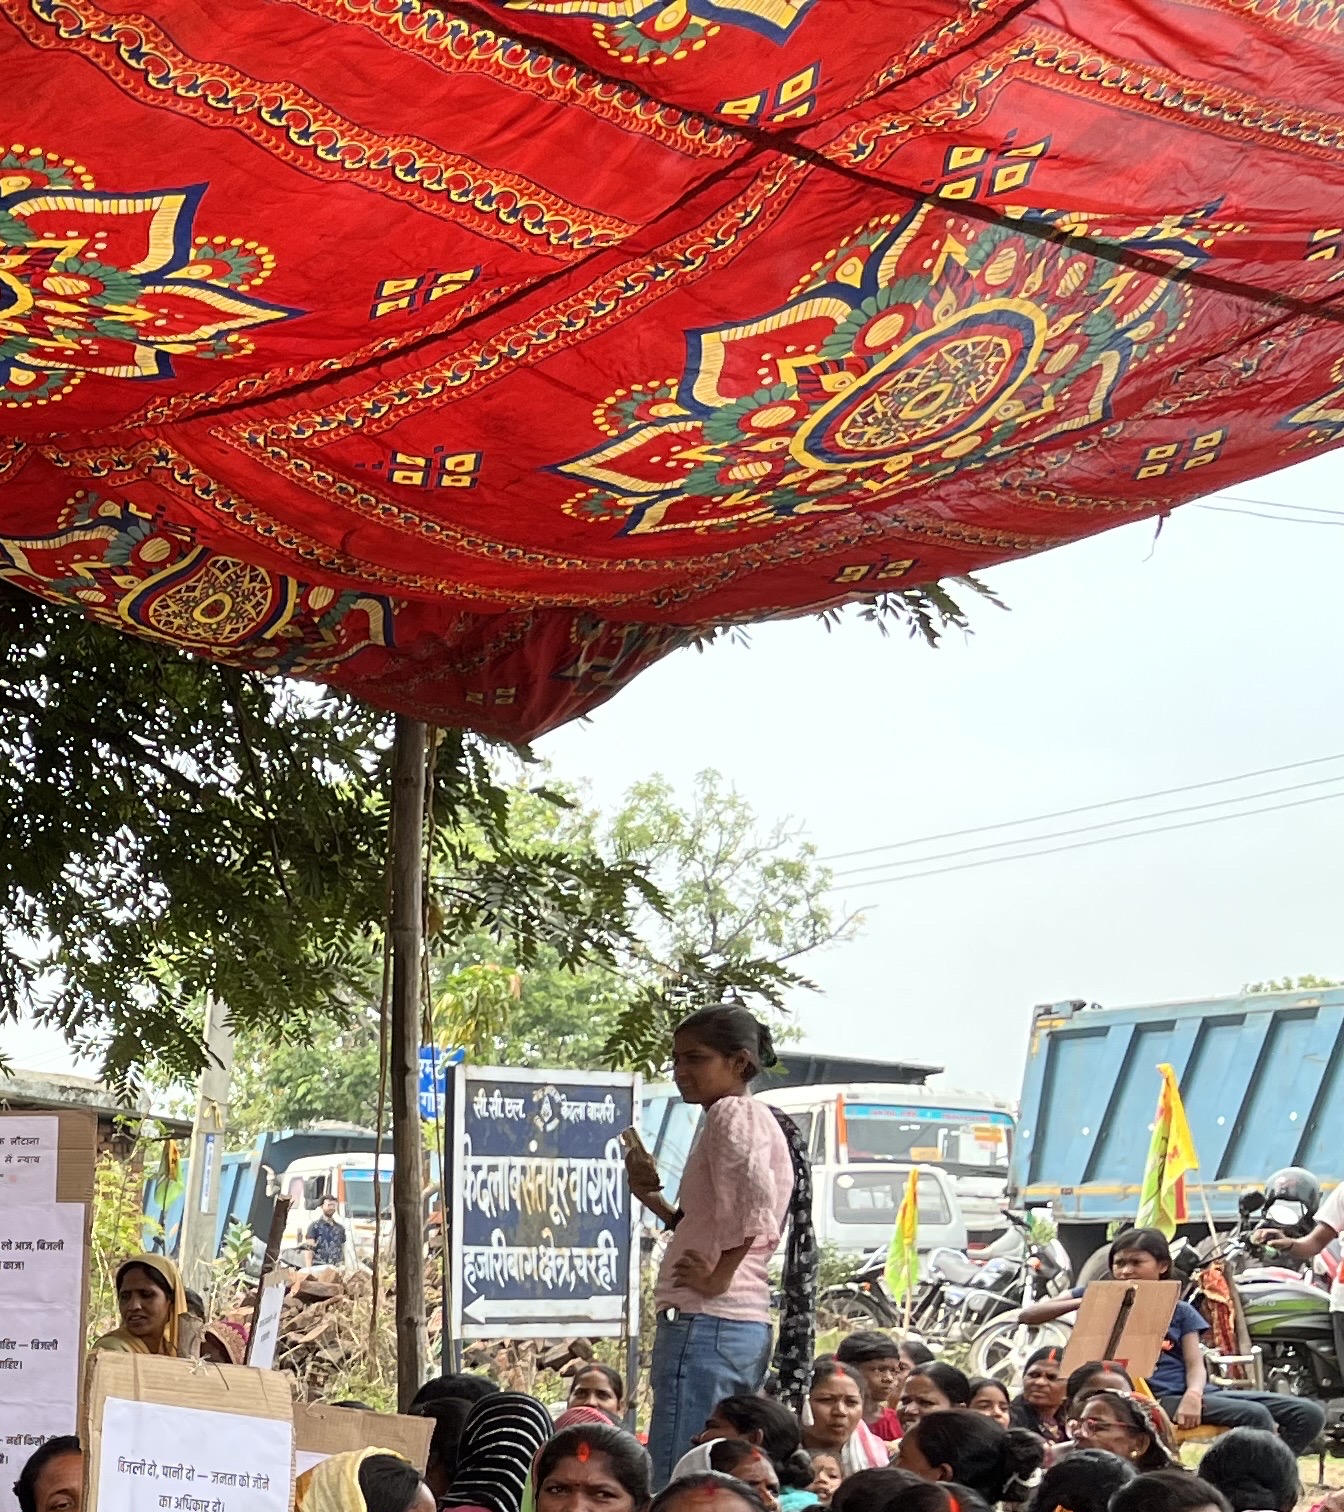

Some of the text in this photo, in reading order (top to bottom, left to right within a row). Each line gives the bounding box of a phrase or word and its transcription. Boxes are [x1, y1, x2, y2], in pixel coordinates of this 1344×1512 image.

[5, 1153, 13, 1163] में
[17, 1155, 41, 1164] न्याय
[0, 1239, 12, 1250] लो
[14, 1240, 34, 1252] आज,
[36, 1239, 64, 1251] बिजली
[31, 1339, 58, 1350] बिजली
[6, 1434, 23, 1446] नहीं
[118, 1456, 146, 1475] बिजली
[148, 1460, 159, 1479] दो,
[162, 1463, 183, 1480] पानी
[186, 1465, 195, 1481] दो
[211, 1471, 237, 1487] जनता
[239, 1471, 250, 1488] को
[252, 1472, 270, 1490] जीने
[158, 1494, 172, 1508] का
[174, 1494, 210, 1512] अधिकार
